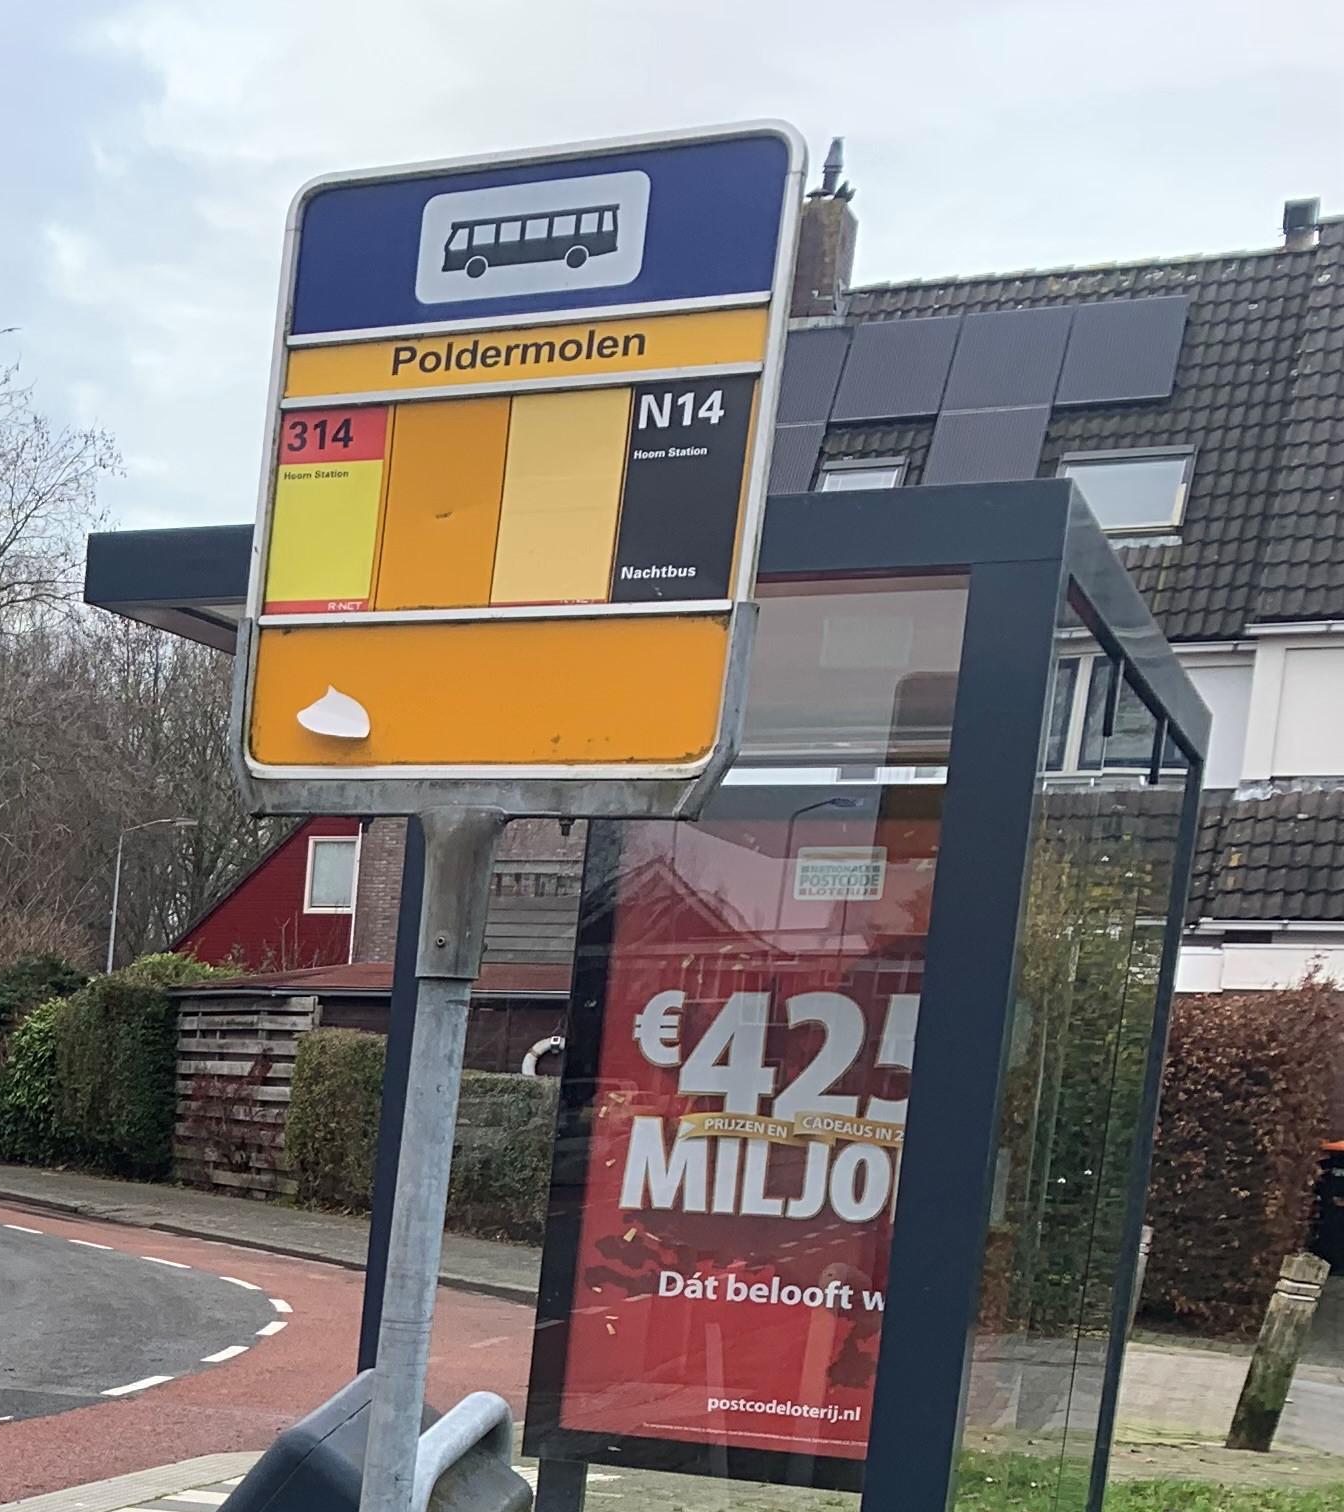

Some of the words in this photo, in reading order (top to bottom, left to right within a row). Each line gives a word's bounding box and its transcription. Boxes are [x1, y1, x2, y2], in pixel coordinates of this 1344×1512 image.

[391, 329, 647, 376] Poldermolen
[638, 389, 725, 430] N14
[286, 418, 354, 452] 314
[633, 449, 666, 460] Hoorn
[668, 446, 709, 457] Station
[283, 471, 312, 481] Hoorn
[314, 469, 350, 480] Station
[620, 564, 697, 580] Nachtbus
[798, 873, 881, 888] POSTCODE
[807, 887, 869, 896] LOTERIJ
[703, 1118, 765, 1136] PRIJZEN
[767, 1123, 788, 1139] EN
[802, 1116, 873, 1138] CADEAUS
[874, 1127, 893, 1141] IN
[619, 1116, 900, 1223] MILJO
[658, 1270, 718, 1300] Dát
[725, 1273, 854, 1310] belooft
[707, 1397, 861, 1423] postcodeloterij.nl
